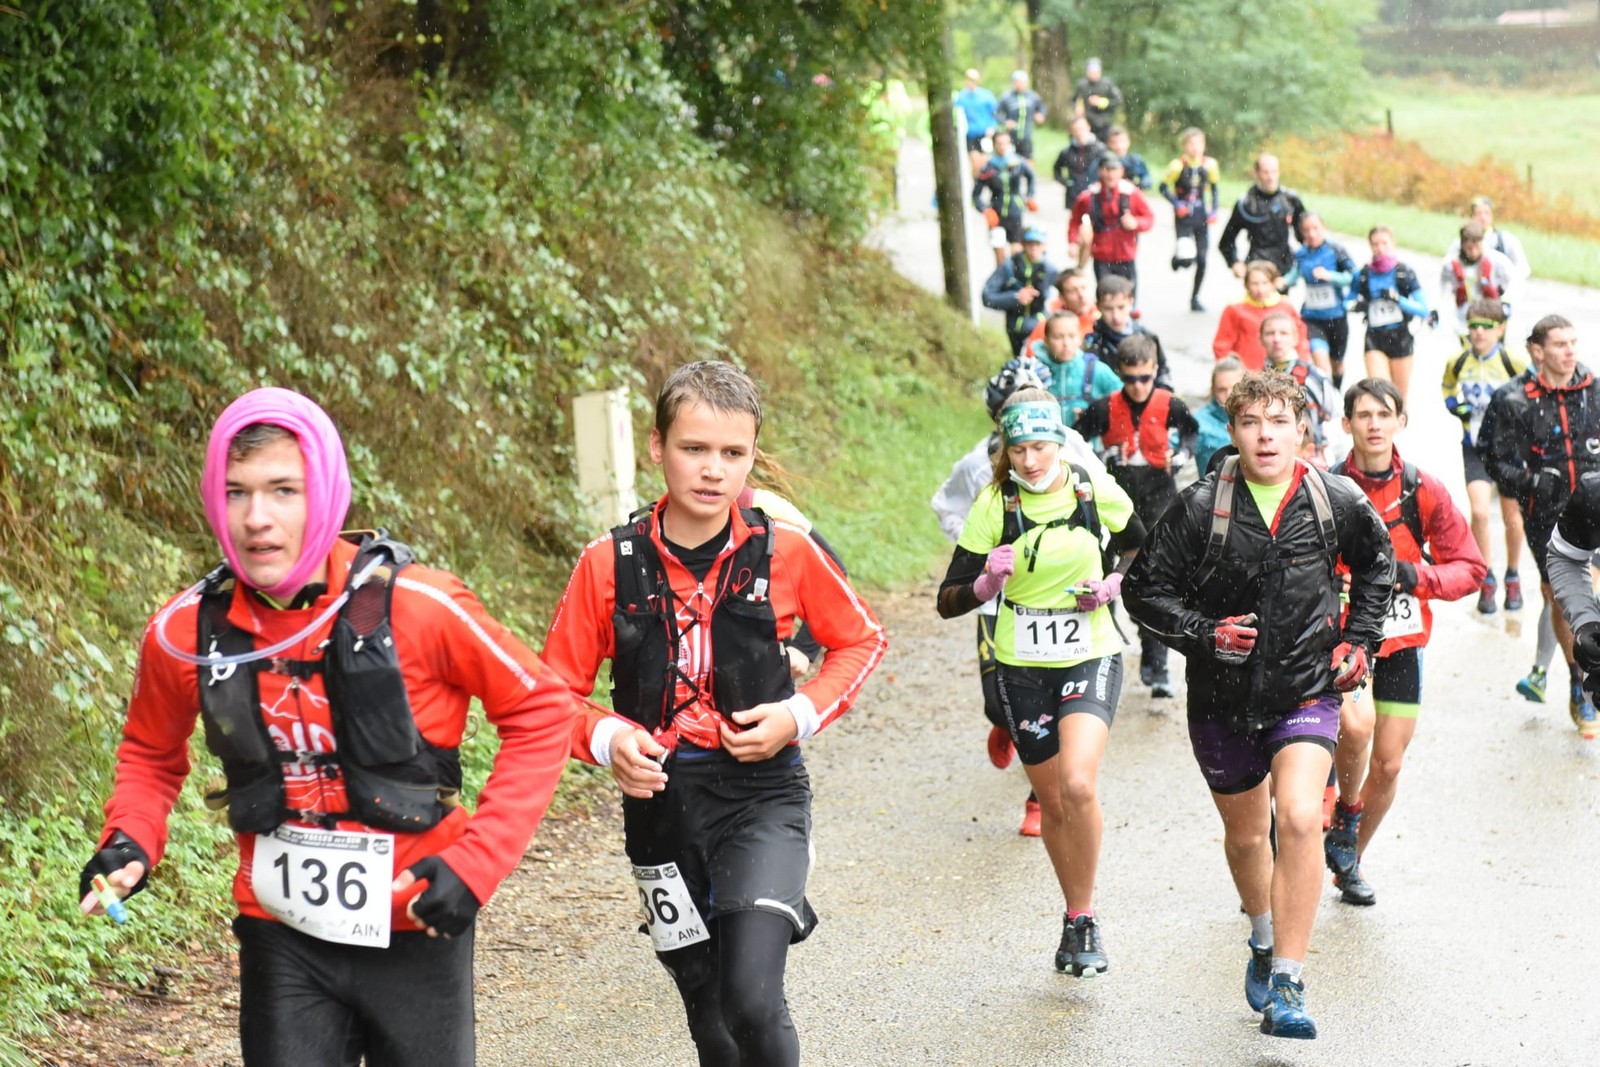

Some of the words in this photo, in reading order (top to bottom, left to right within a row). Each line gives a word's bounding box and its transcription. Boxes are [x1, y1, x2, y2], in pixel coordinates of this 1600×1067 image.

[1026, 618, 1080, 645] 112
[1073, 646, 1088, 655] AIN
[1061, 680, 1089, 696] 01
[1287, 717, 1321, 725] OFFLOAD
[274, 852, 368, 911] 136
[352, 923, 380, 938] AIN
[677, 926, 701, 942] AIN
